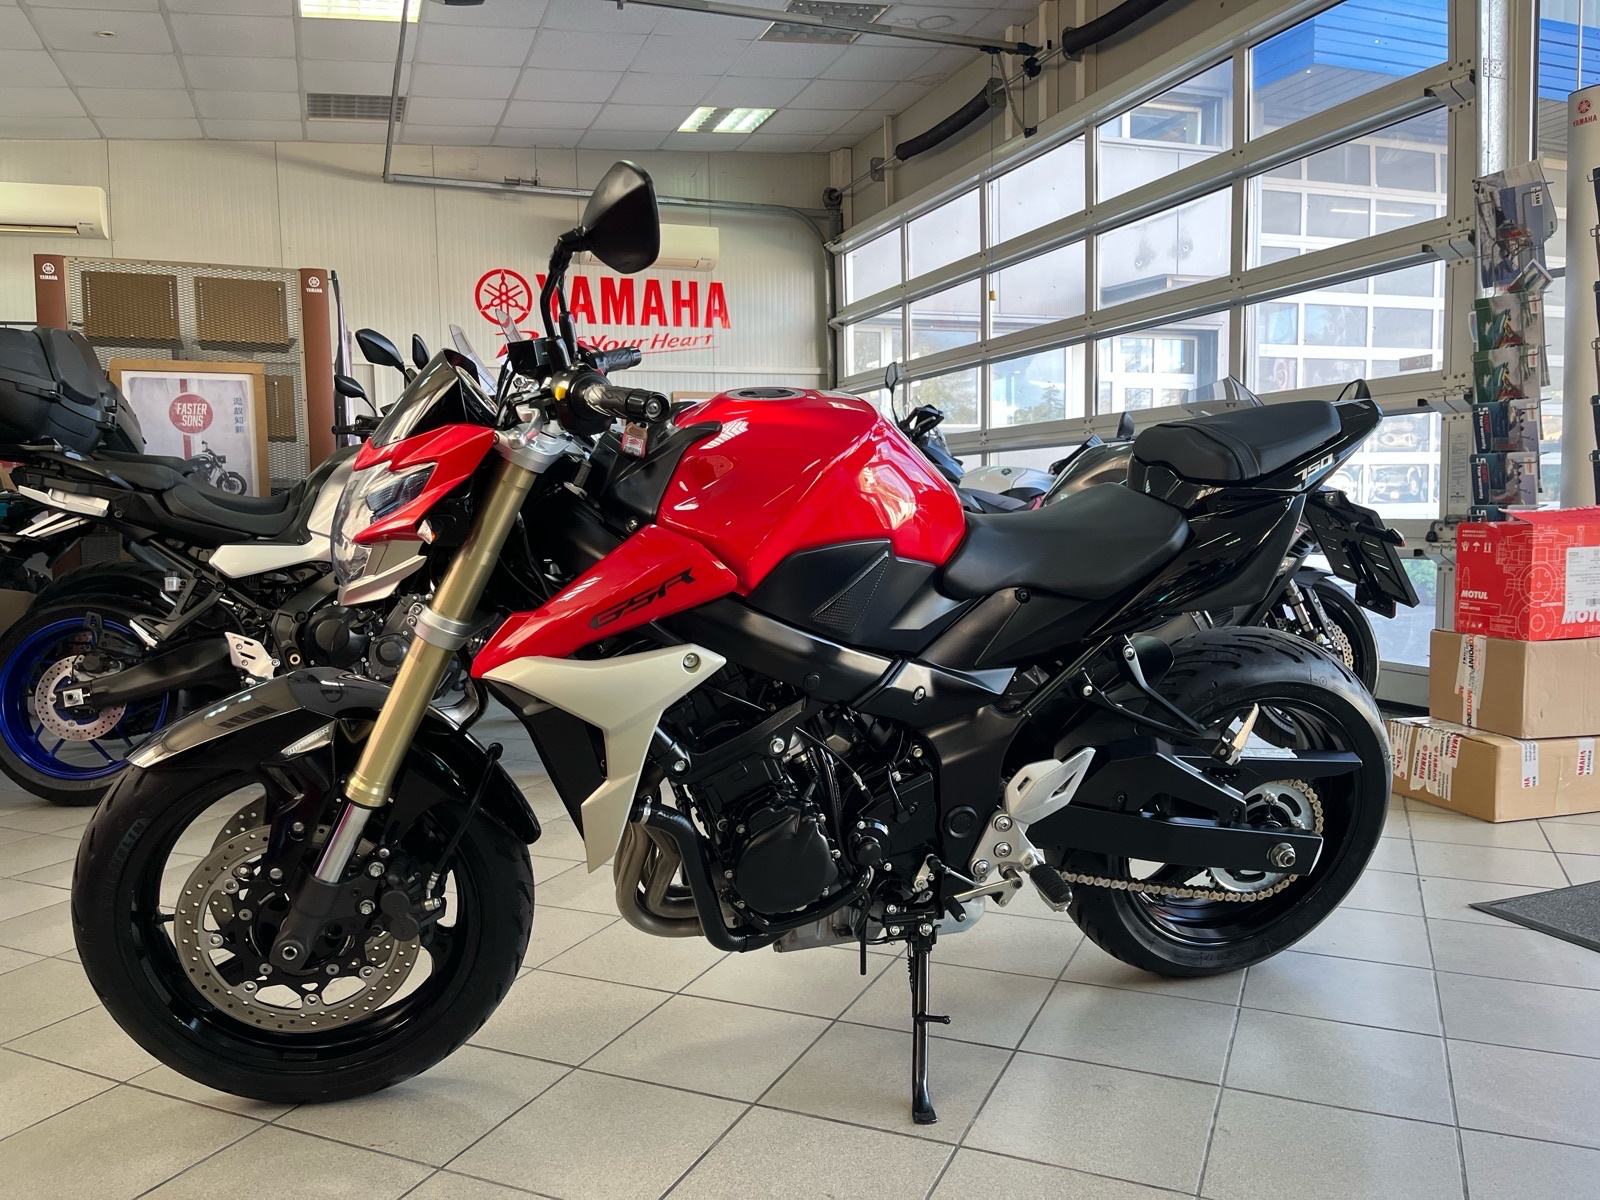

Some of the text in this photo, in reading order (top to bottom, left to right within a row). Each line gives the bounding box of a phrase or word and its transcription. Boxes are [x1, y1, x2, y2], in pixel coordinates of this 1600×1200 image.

[1573, 114, 1597, 127] YAMAHA
[650, 332, 714, 350] Heart
[176, 402, 208, 415] FASTER
[181, 414, 204, 427] SONS
[1294, 452, 1334, 481] 750
[588, 568, 696, 629] GSR
[1460, 589, 1489, 600] MOTUL
[1418, 752, 1428, 779] YAMAHA
